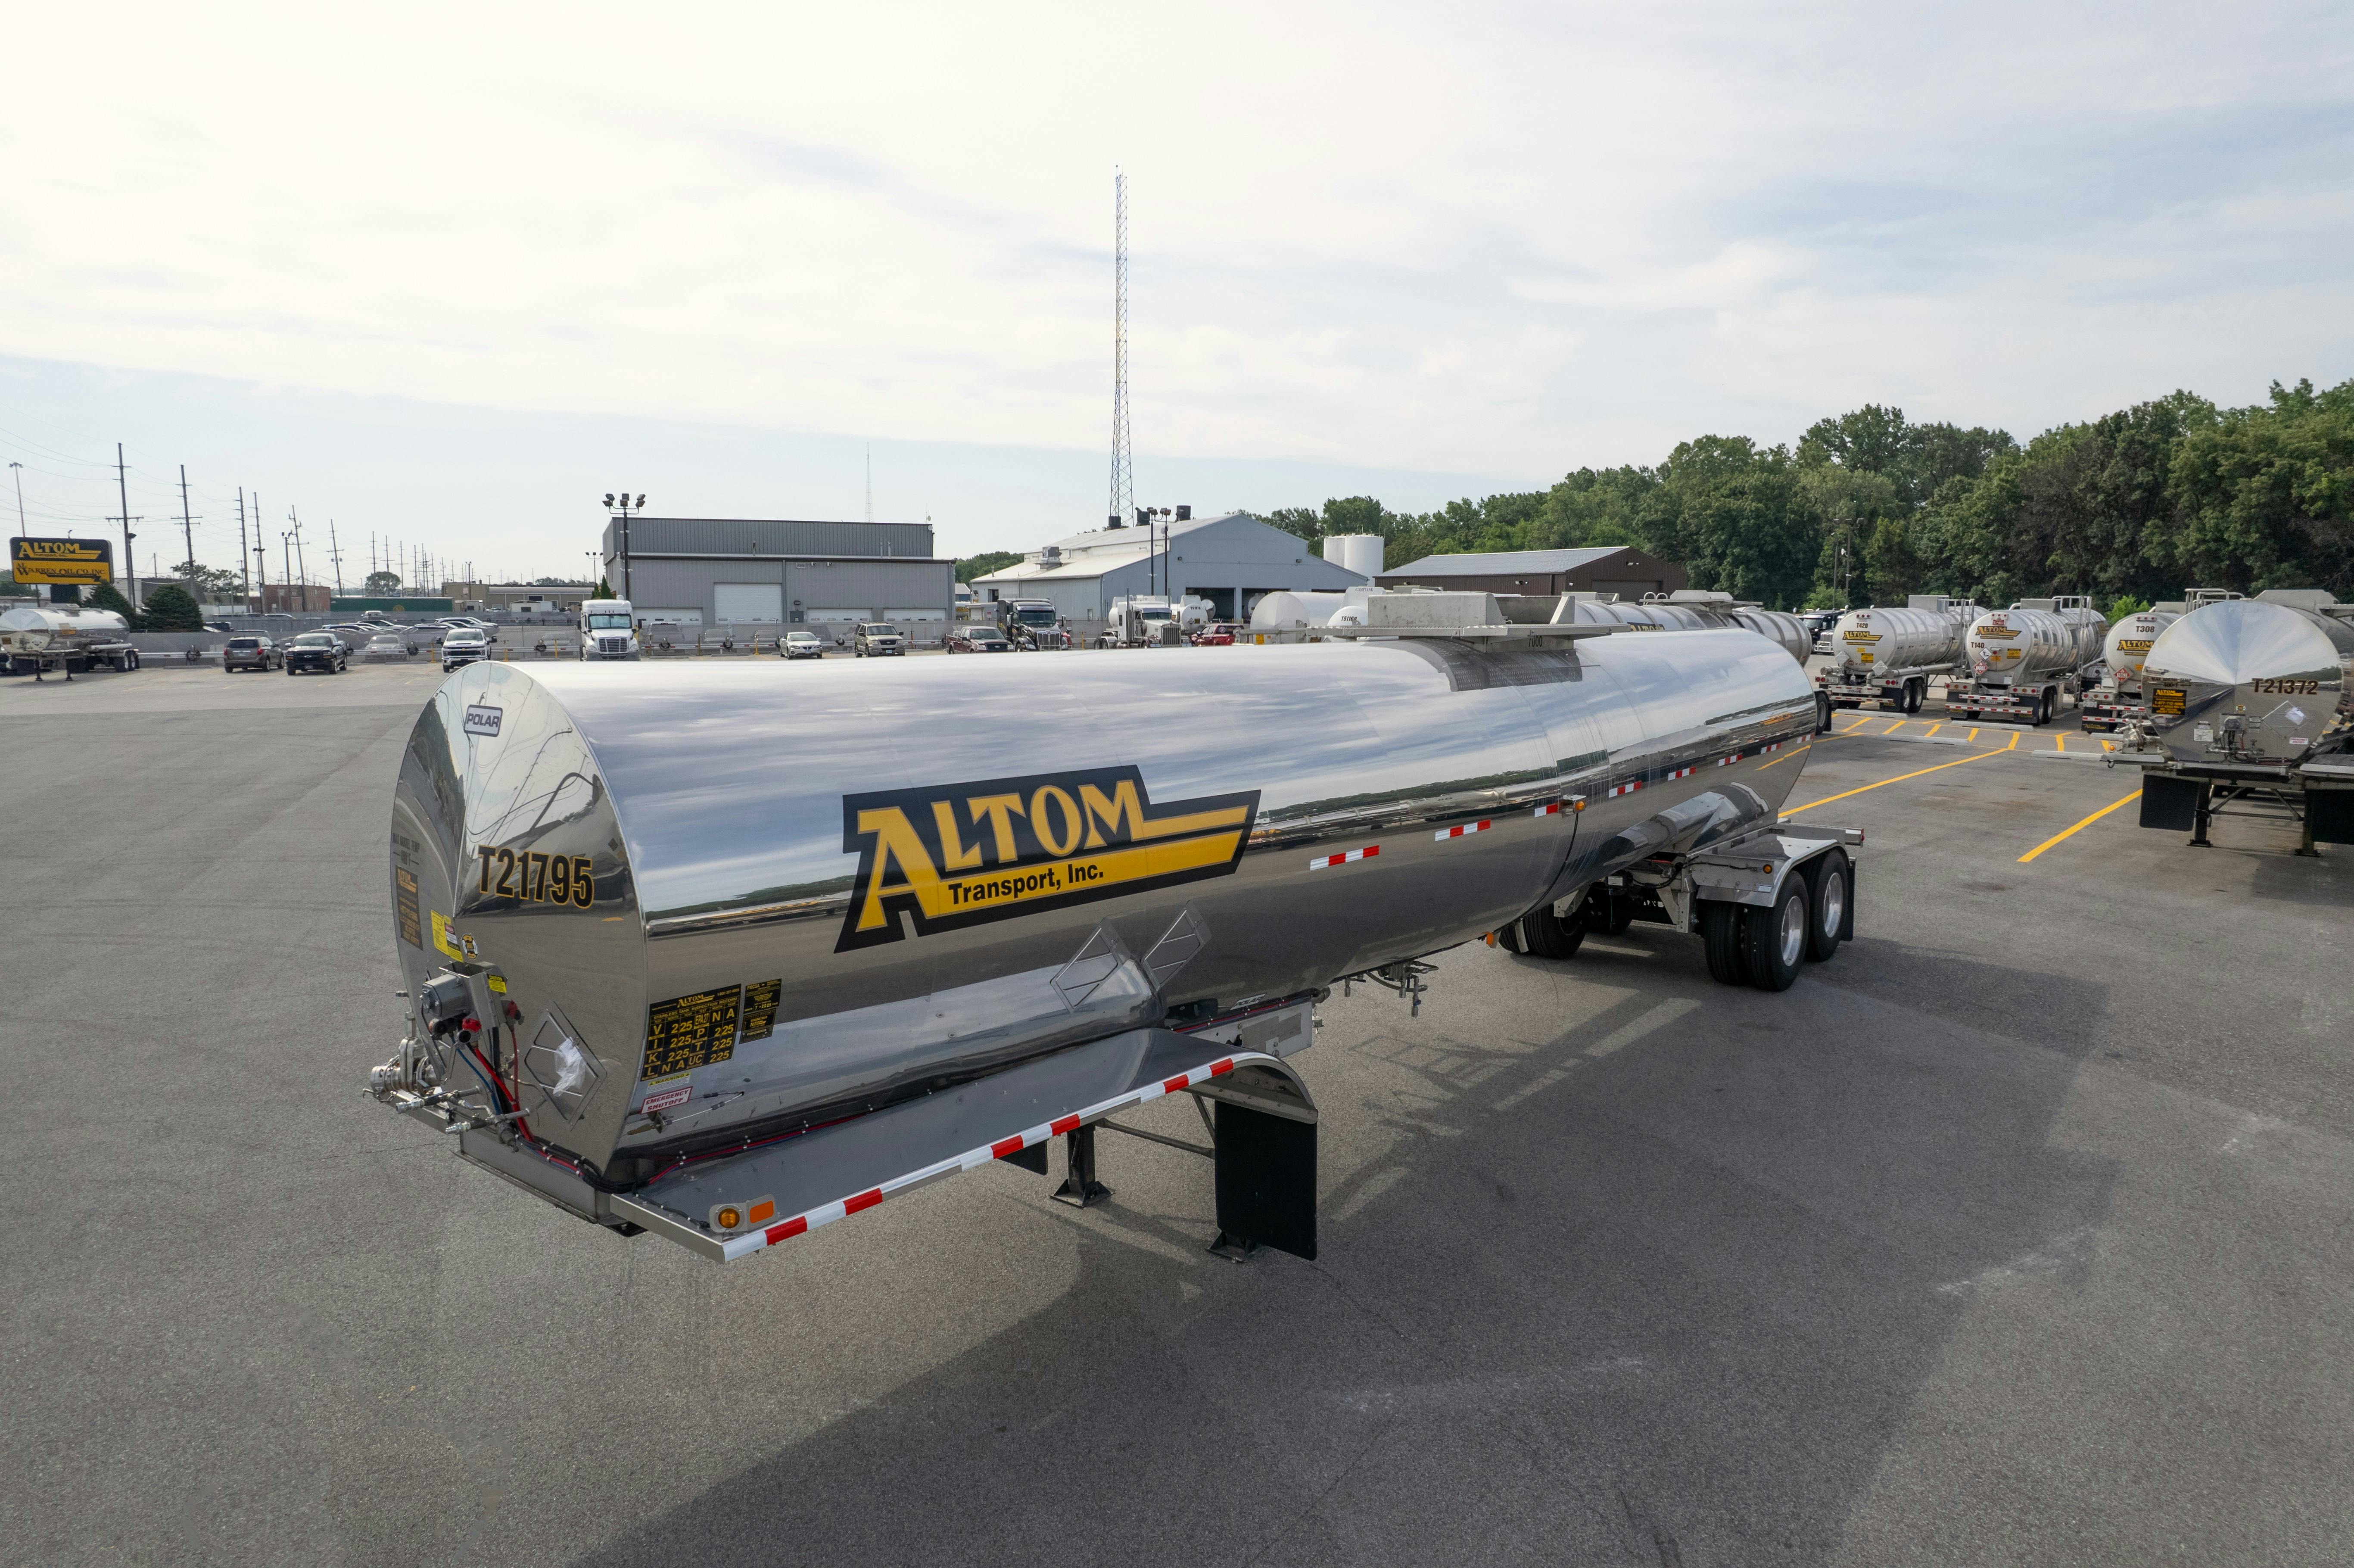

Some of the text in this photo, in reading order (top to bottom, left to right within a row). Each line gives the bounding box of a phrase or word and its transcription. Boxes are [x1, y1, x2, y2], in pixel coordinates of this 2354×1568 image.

[19, 541, 80, 558] ALTOM
[16, 566, 56, 576] WARREN
[1843, 631, 1869, 640] ALTOM
[1976, 626, 2007, 635] ALTOM
[2118, 640, 2154, 650] ALTOM
[2252, 678, 2319, 695] T21372
[466, 713, 500, 728] POLAR
[855, 779, 1145, 933] ALTOM
[478, 844, 594, 909] T21795
[948, 862, 1104, 905] Transport, Inc.
[677, 994, 704, 1008] ALTOM
[654, 1010, 678, 1019] STAINLESS
[654, 1024, 662, 1035] V
[712, 1011, 721, 1022] N
[726, 1008, 735, 1019] A
[654, 1039, 658, 1049] I
[697, 1028, 705, 1038] P
[648, 1053, 658, 1063] K
[695, 1042, 703, 1051] T
[647, 1067, 655, 1076] L
[661, 1063, 671, 1073] N
[676, 1060, 685, 1069] A
[689, 1055, 703, 1065] UC
[655, 1073, 685, 1084] WARNING
[645, 1089, 689, 1105] EMERGENCY
[647, 1097, 684, 1111] SHUTOFF
